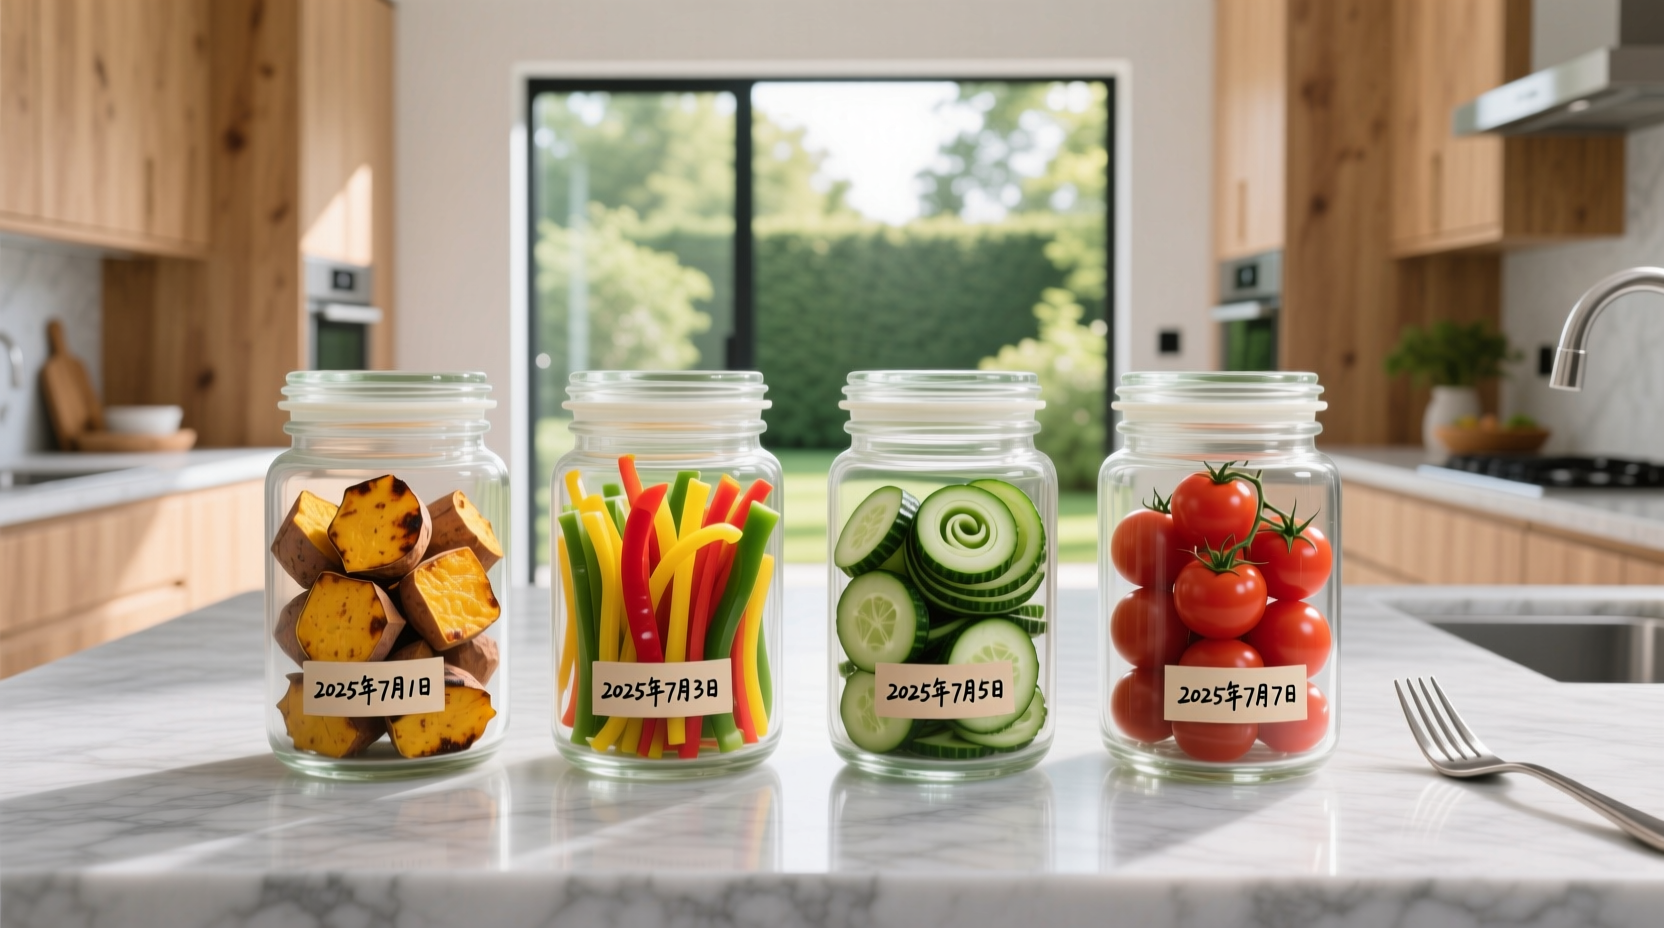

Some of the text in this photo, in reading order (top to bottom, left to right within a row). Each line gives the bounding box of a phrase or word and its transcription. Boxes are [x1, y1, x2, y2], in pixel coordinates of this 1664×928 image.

[313, 674, 431, 706] 2025年7月1日
[600, 676, 718, 708] 2025年7月3日
[886, 677, 1003, 708] 2025年7月5日
[1177, 680, 1296, 712] 2025年7月7日
